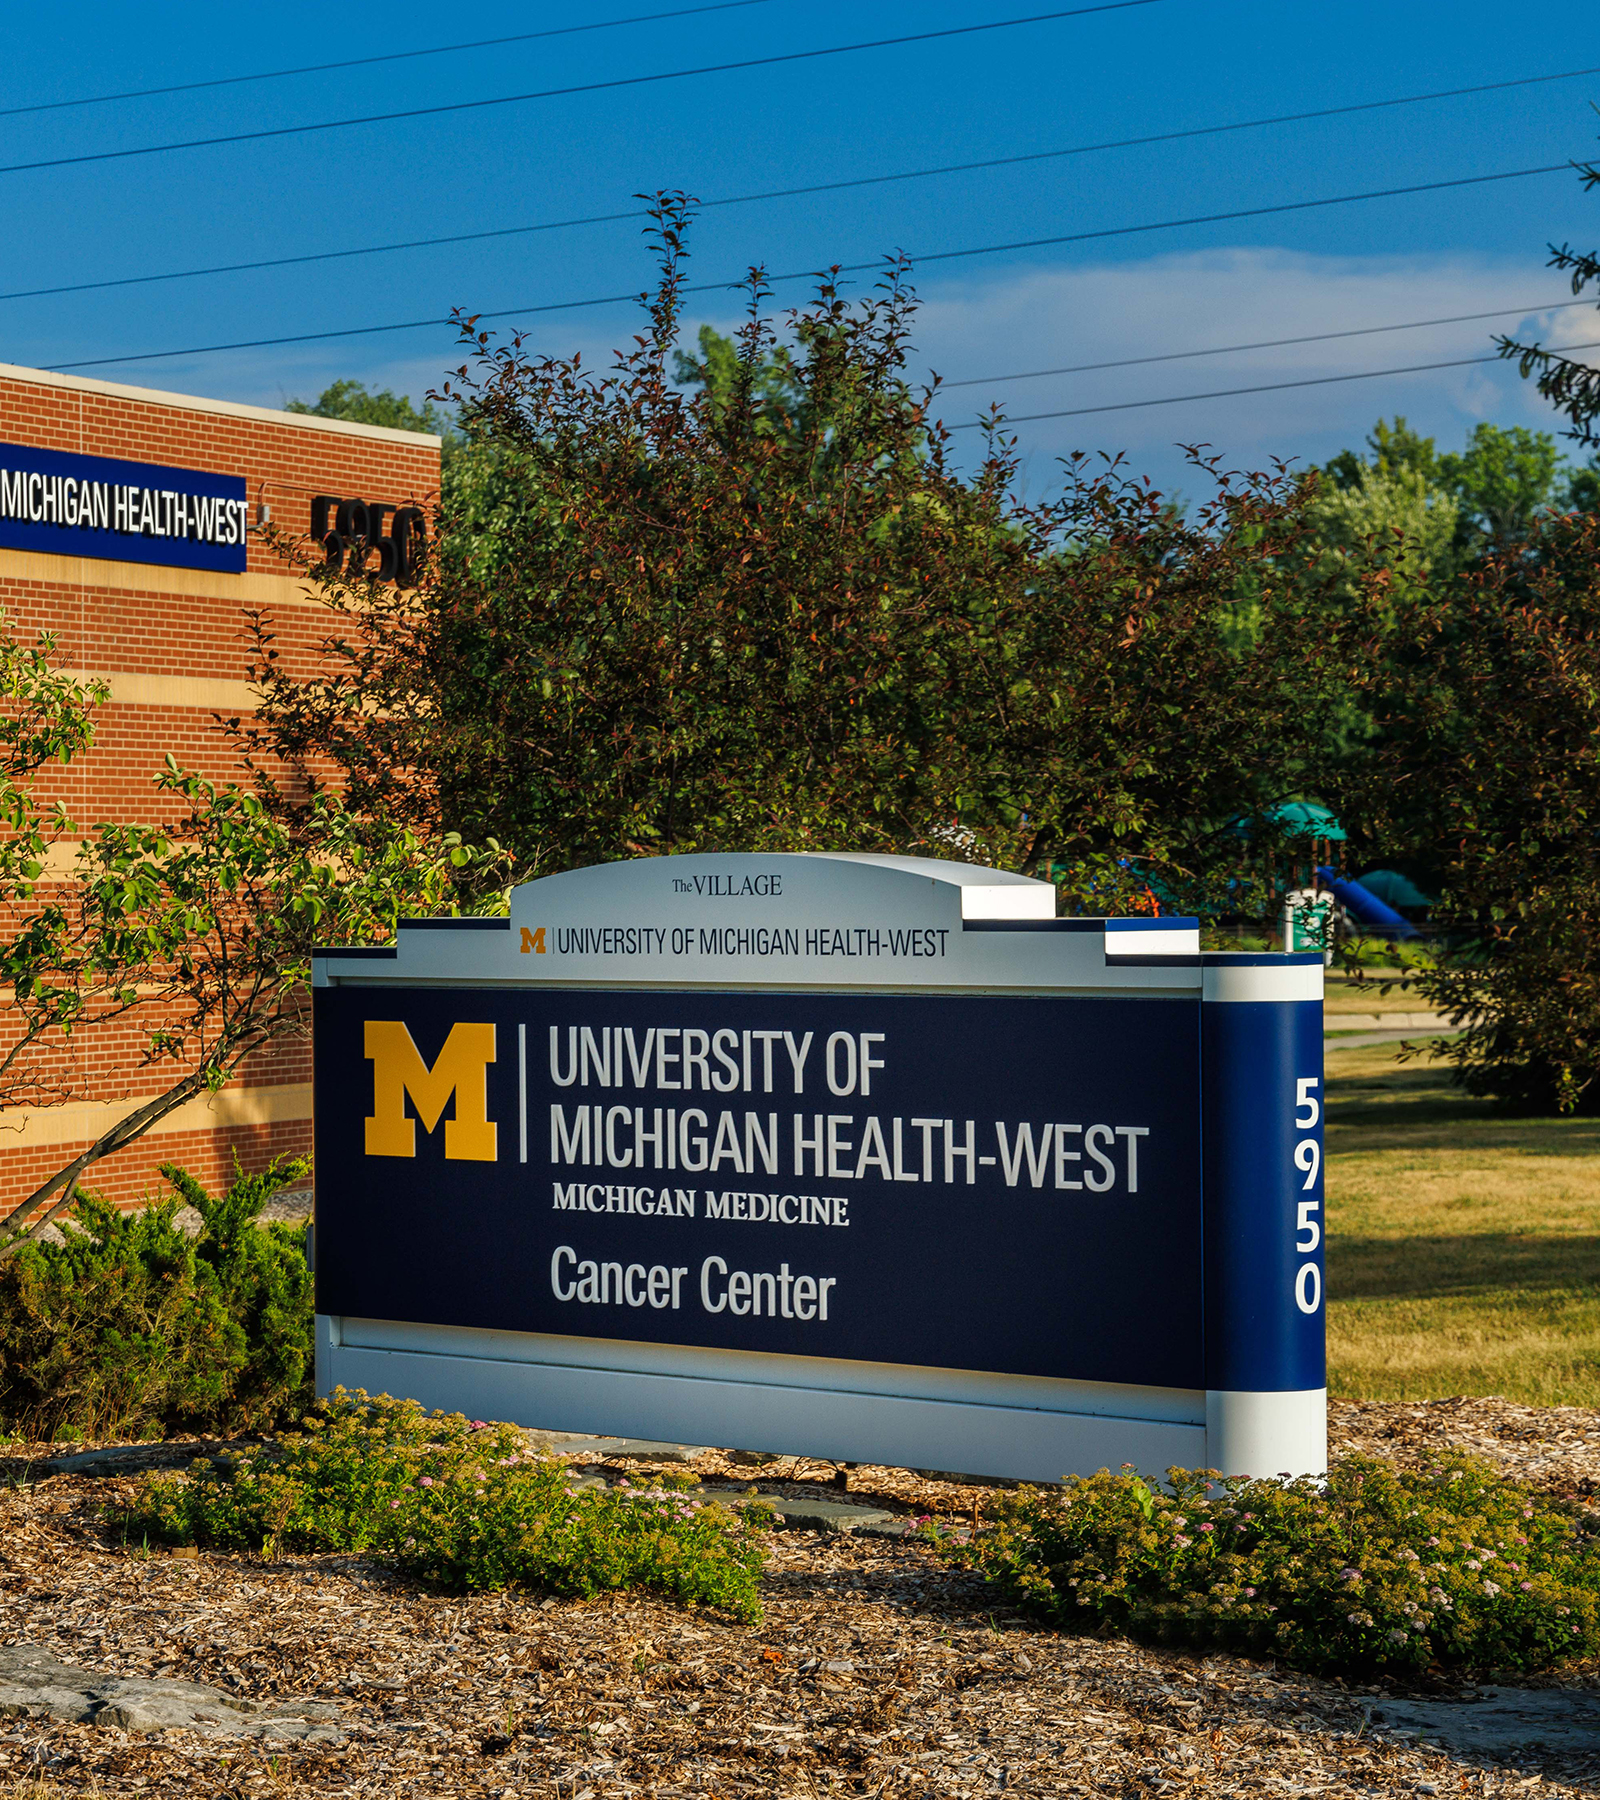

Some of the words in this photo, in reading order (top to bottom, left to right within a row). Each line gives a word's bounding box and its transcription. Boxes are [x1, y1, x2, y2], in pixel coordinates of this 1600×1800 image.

[1, 468, 109, 530] MICHIGAN
[114, 484, 250, 546] HEALTH-WEST
[311, 495, 427, 588] 5950
[693, 875, 783, 897] VILLAGE
[520, 927, 547, 954] M
[557, 927, 667, 955] UNIVERSITY
[671, 927, 696, 956] OF
[699, 928, 800, 956] MICHIGAN
[805, 929, 950, 957] HEALTH-WEST
[364, 1020, 498, 1162] M
[549, 1025, 814, 1094] UNIVERSITY
[825, 1030, 886, 1096] OF
[550, 1103, 778, 1175] MICHIGAN
[793, 1113, 1150, 1193] HEALTH-WEST
[552, 1182, 697, 1218] MICHIGAN
[704, 1190, 850, 1227] MEDICINE
[1293, 1077, 1321, 1315] 5950
[550, 1245, 688, 1309] Cancer
[700, 1255, 837, 1321] Center
